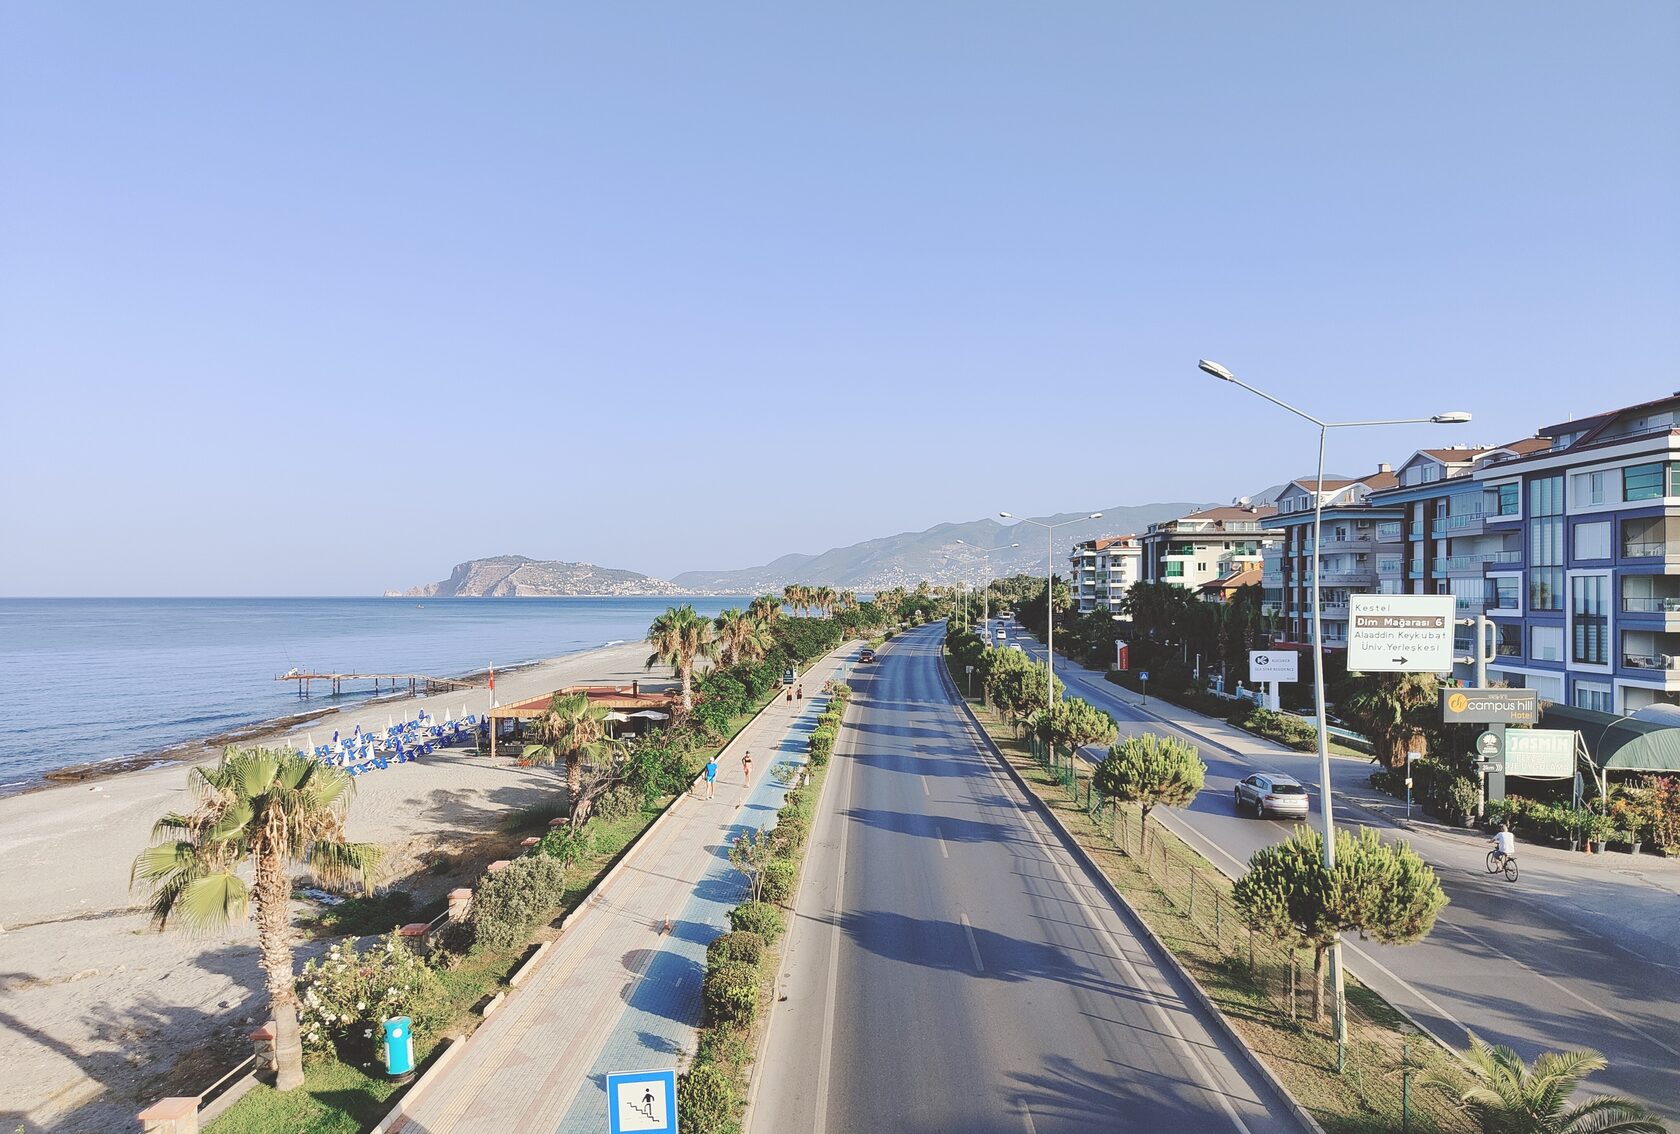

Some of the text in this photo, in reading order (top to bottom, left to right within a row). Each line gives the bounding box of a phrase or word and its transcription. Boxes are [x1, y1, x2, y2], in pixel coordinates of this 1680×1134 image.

[1355, 604, 1391, 612] Kestel
[1384, 618, 1430, 628] Mağarası
[1435, 618, 1443, 626] 6
[1354, 631, 1446, 641] Alaaddin Keykubat
[1468, 700, 1533, 712] campus hill
[1510, 711, 1533, 719] Hotel
